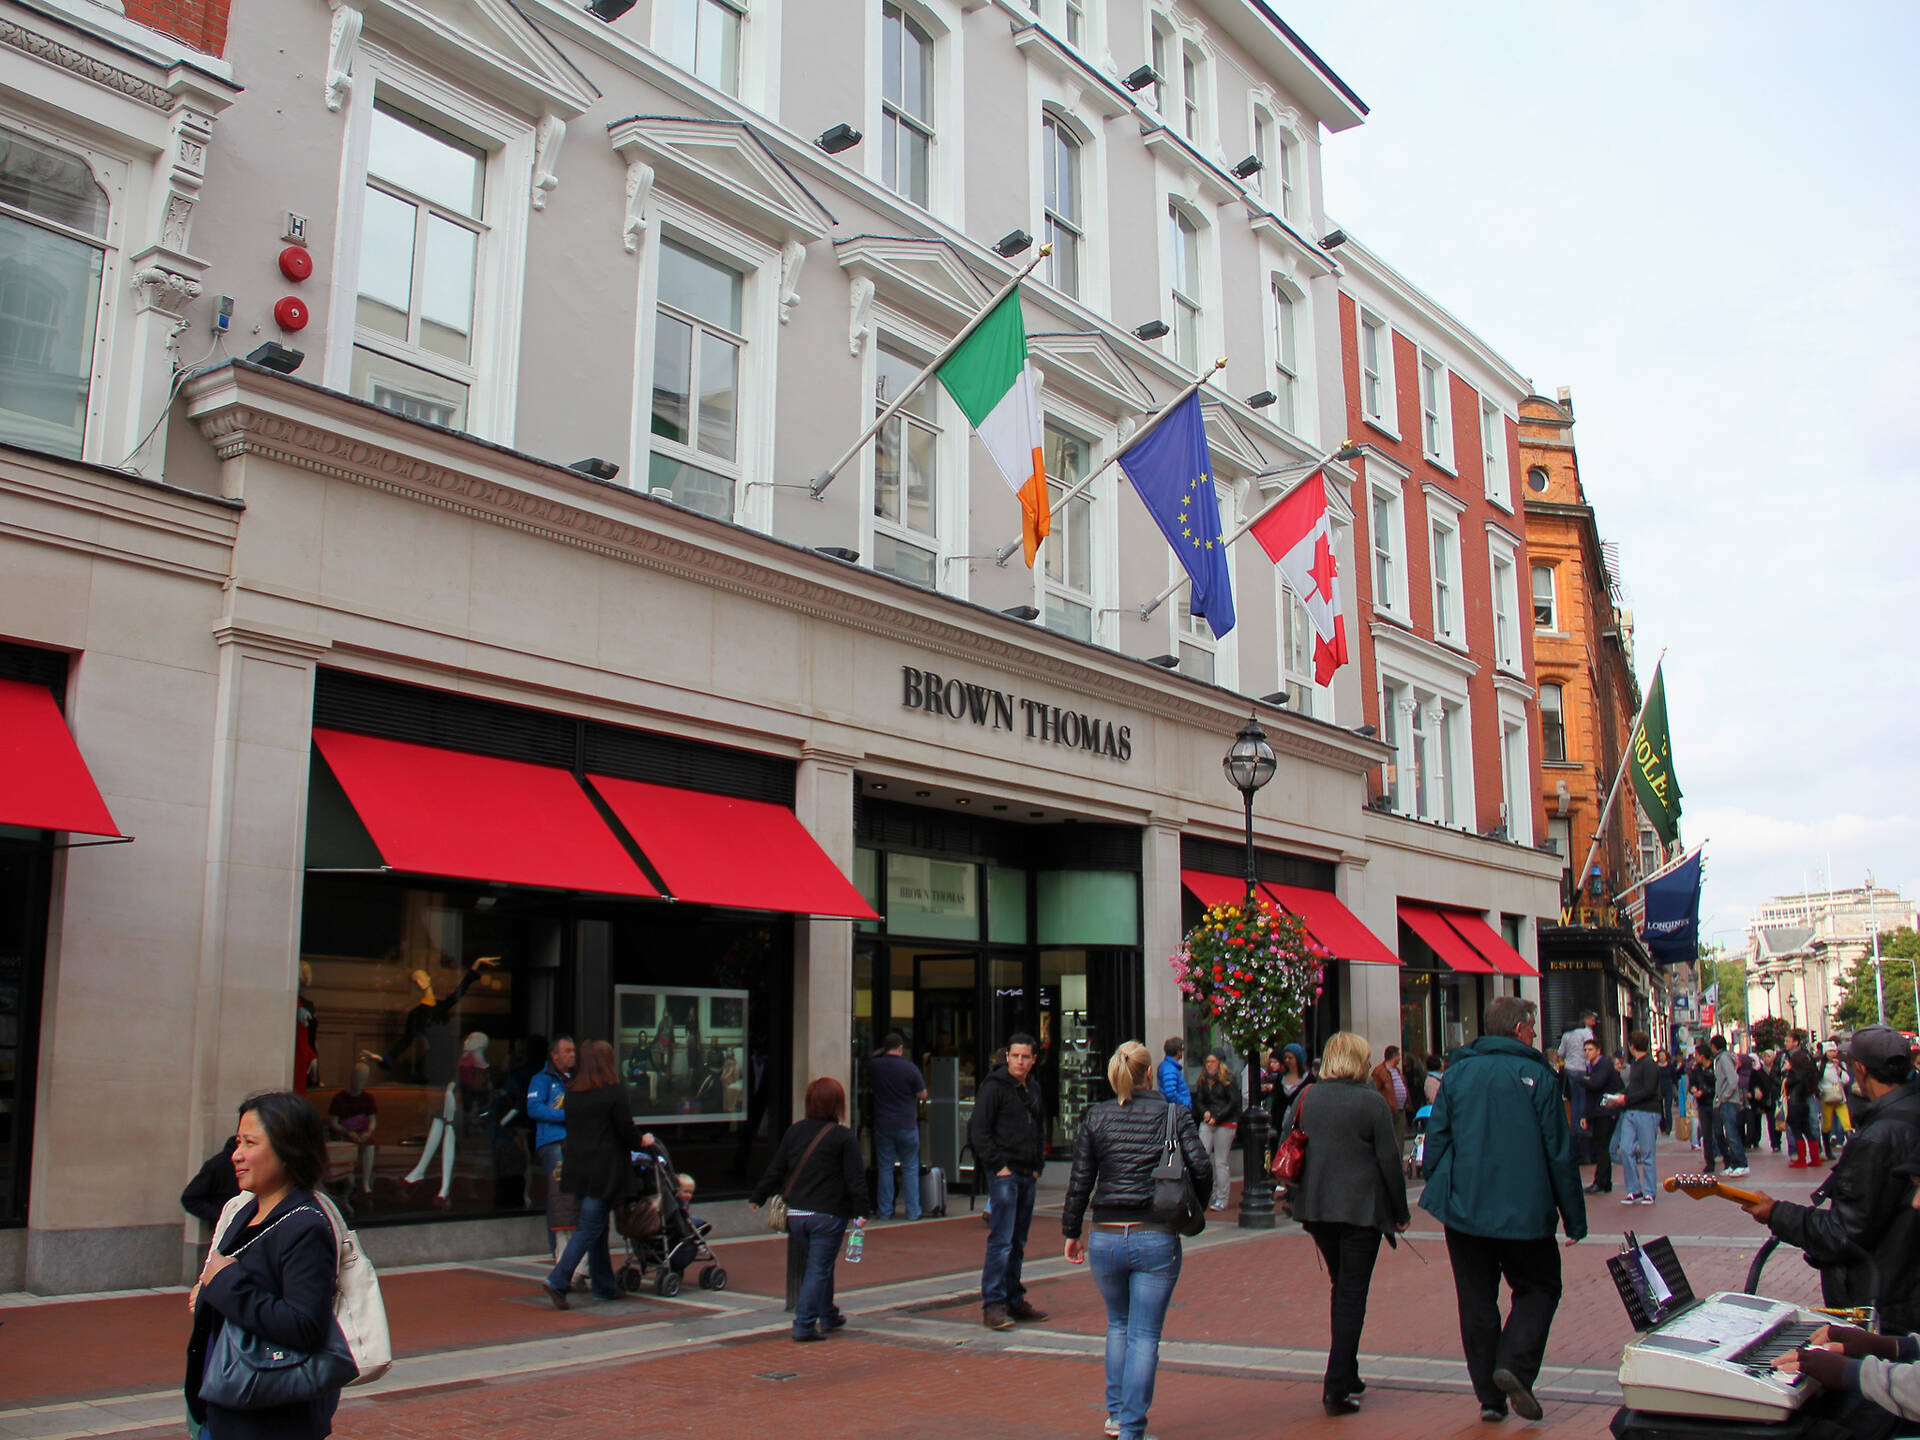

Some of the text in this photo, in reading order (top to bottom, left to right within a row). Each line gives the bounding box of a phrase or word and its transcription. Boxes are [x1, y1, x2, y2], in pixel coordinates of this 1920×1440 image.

[291, 217, 304, 237] H
[901, 665, 1131, 761] BROWN THOMAS
[1635, 722, 1669, 815] ROLE
[1557, 906, 1618, 928] WEIR
